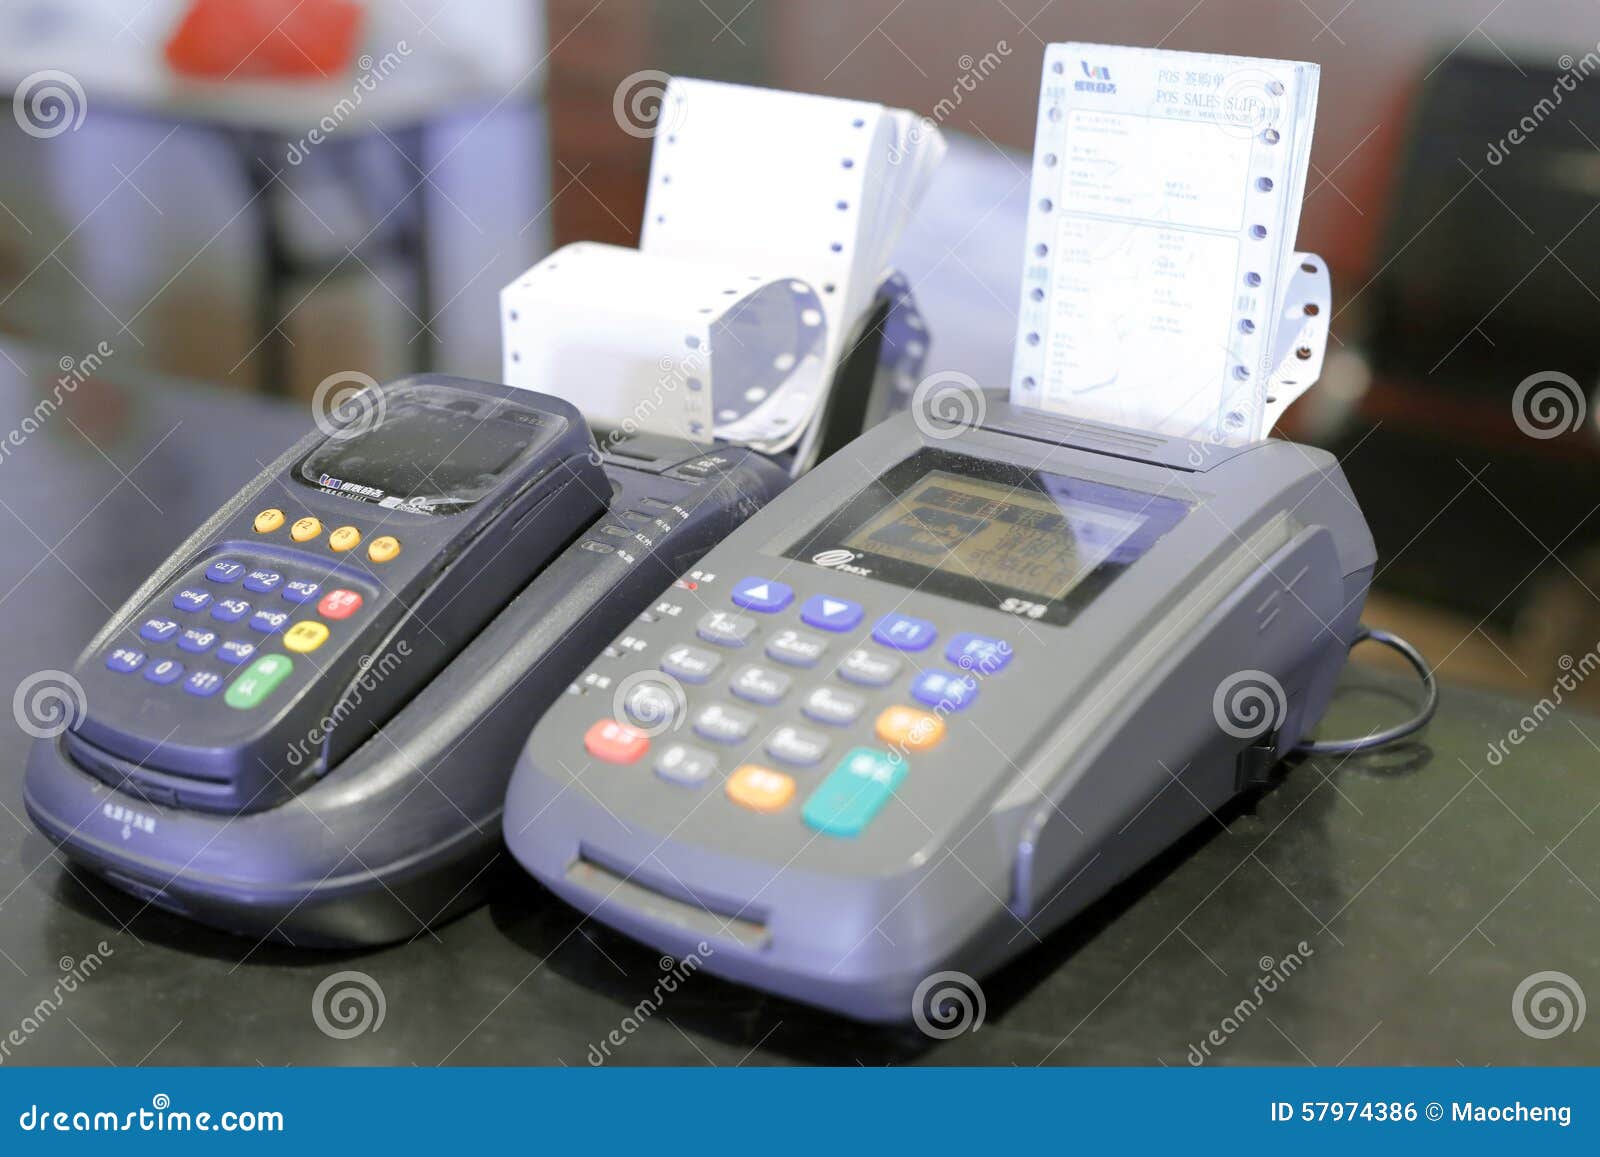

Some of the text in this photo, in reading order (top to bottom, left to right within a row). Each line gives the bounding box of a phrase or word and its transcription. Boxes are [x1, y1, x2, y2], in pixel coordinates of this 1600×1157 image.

[1184, 92, 1221, 108] SALES
[260, 511, 275, 521] F1
[296, 519, 313, 530] F2
[333, 529, 351, 540] F3
